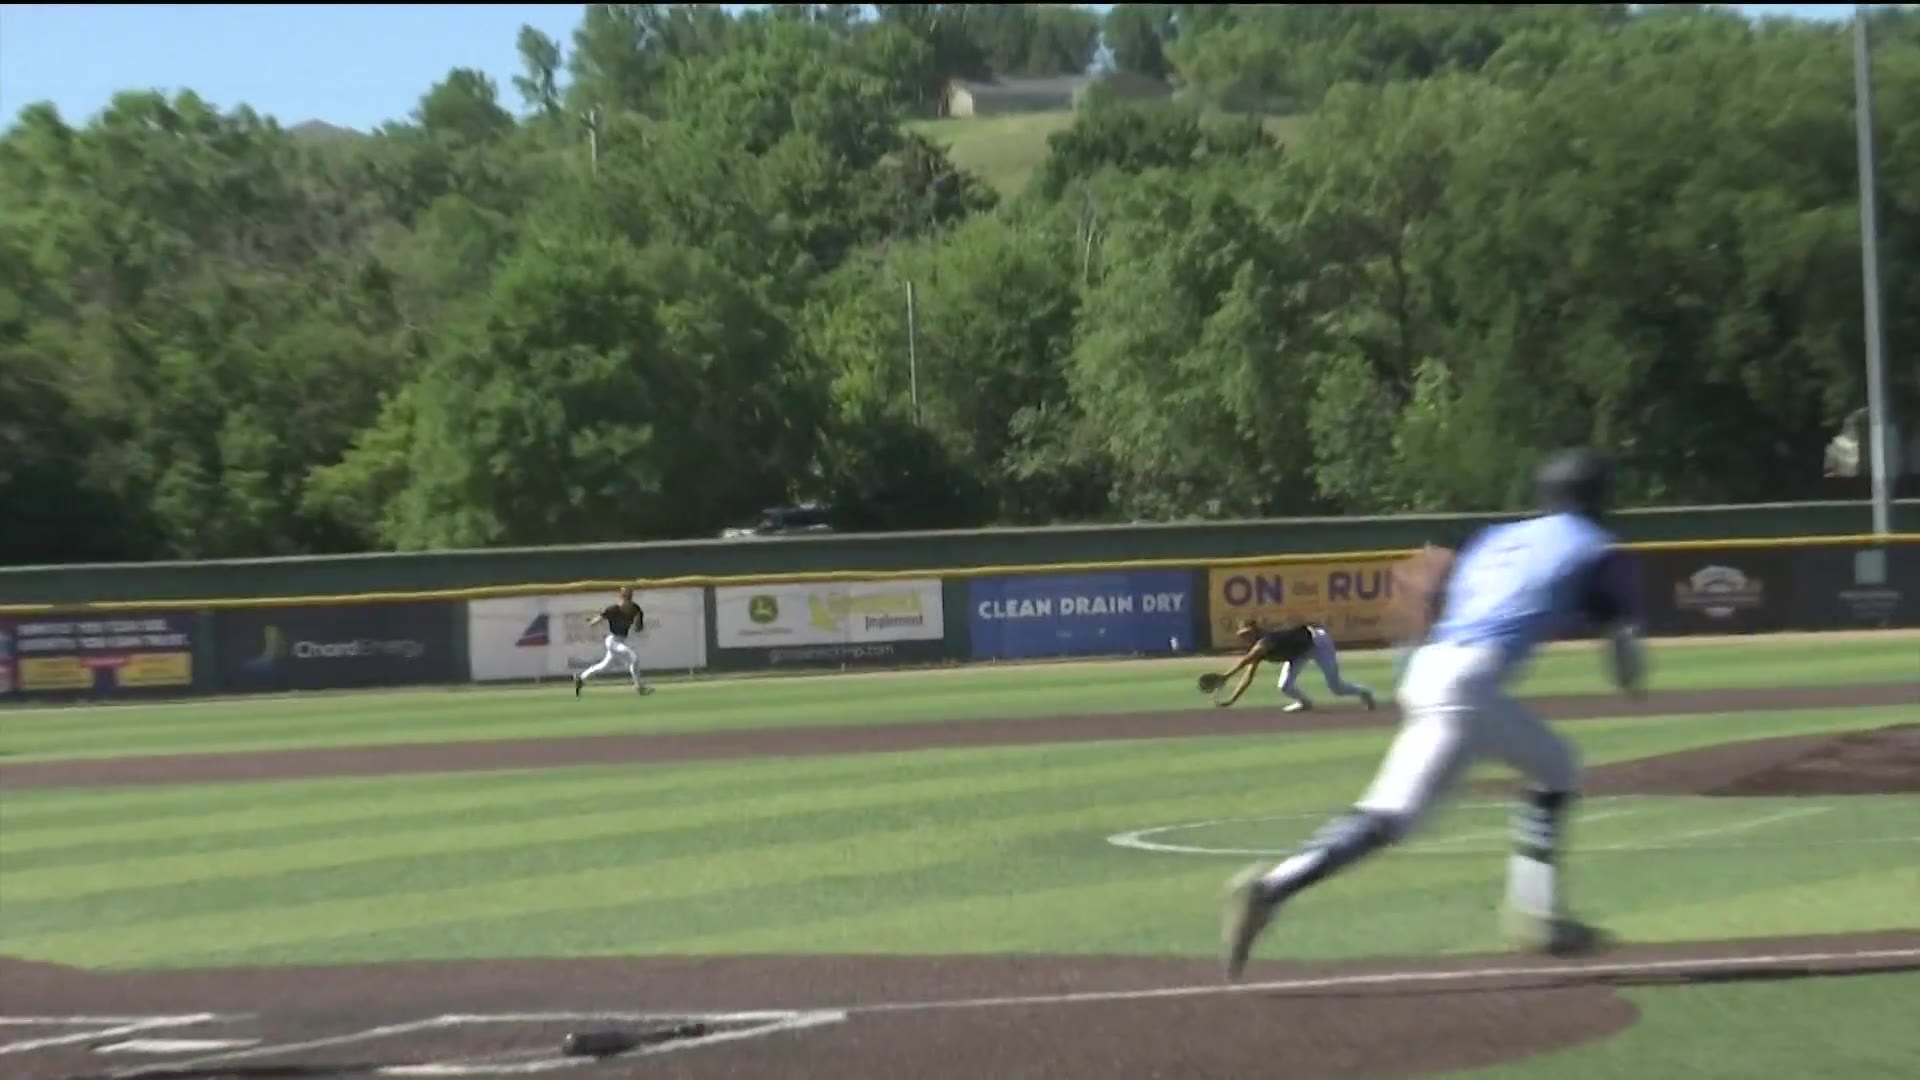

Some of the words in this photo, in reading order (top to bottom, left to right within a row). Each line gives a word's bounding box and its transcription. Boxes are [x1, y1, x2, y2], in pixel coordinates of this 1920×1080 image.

[1223, 574, 1284, 607] ON
[977, 598, 1052, 620] CLEAN
[1060, 595, 1133, 616] DRAIN
[1142, 592, 1185, 613] DRY
[865, 614, 924, 631] Implement
